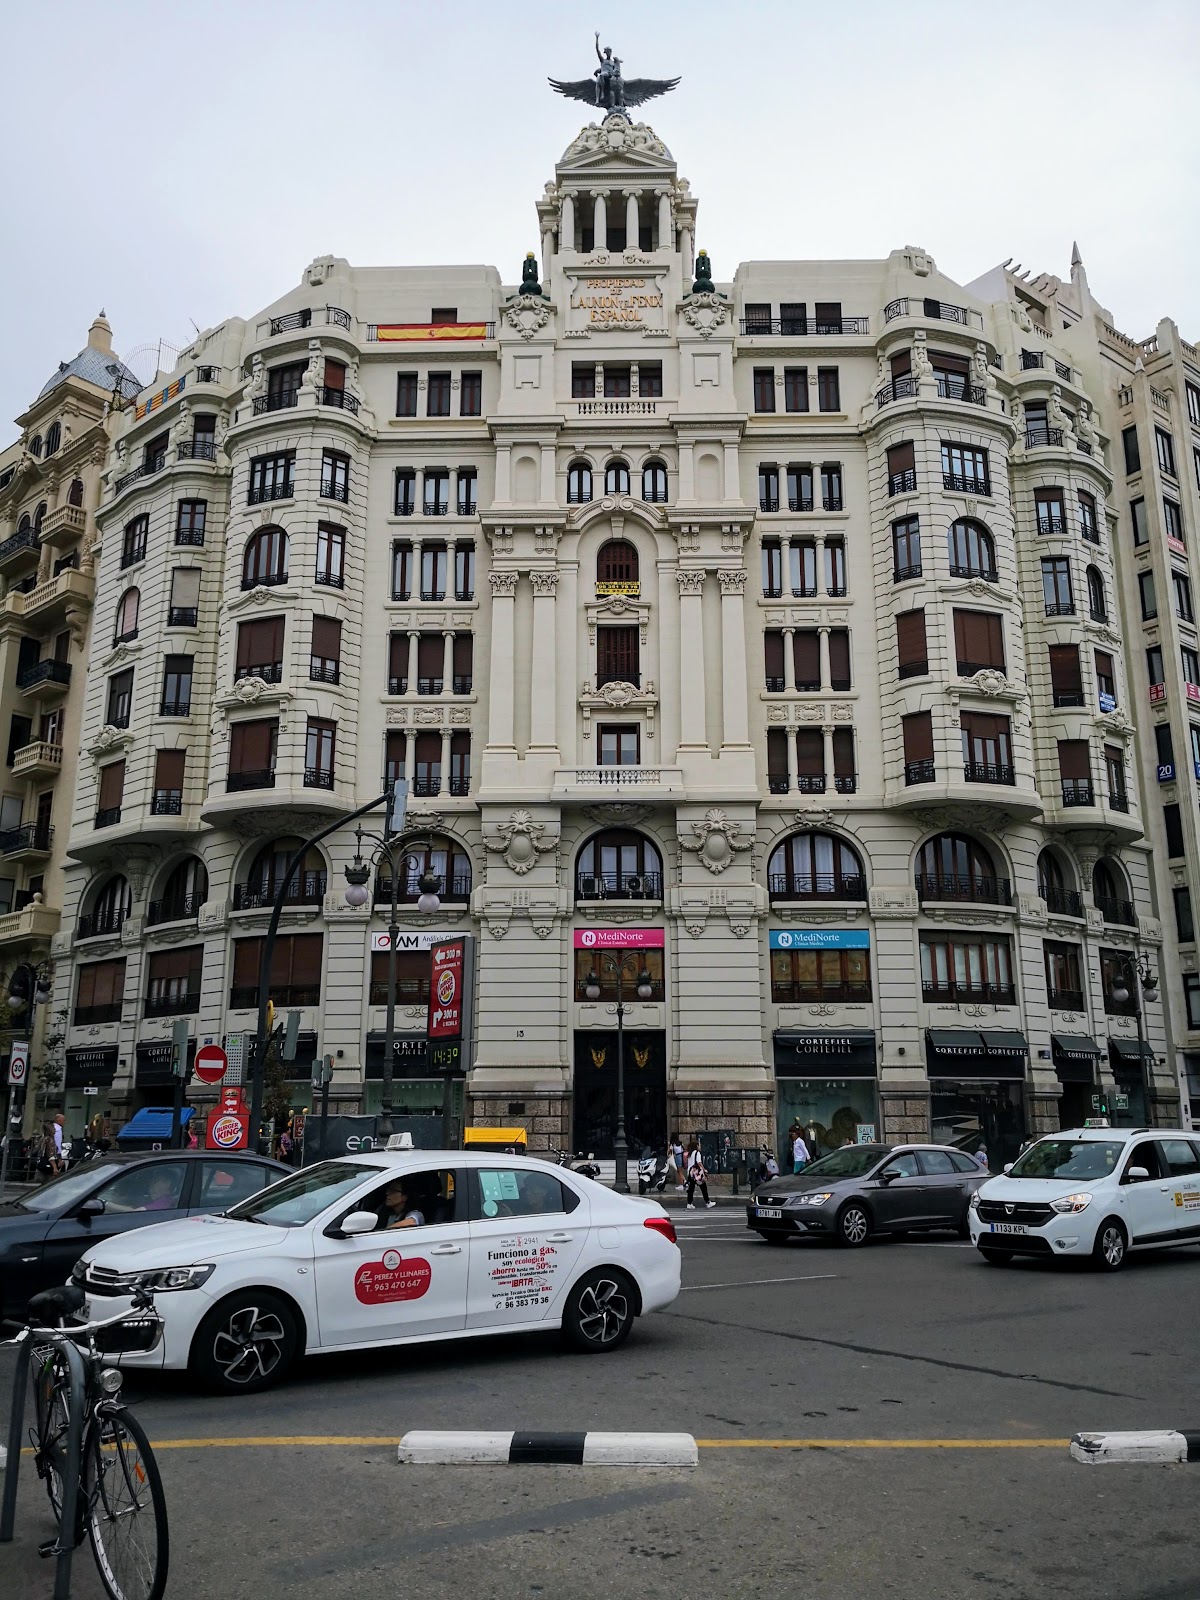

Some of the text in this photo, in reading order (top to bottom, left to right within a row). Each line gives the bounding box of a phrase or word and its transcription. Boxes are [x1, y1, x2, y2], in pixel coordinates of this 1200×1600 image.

[587, 279, 646, 288] PROPIEDAD
[571, 297, 586, 309] LA
[631, 296, 662, 308] FENIX
[591, 309, 642, 322] ESPAÑOL
[1159, 765, 1172, 776] 20
[598, 932, 643, 940] MediNorte
[795, 934, 839, 942] MediNorte
[440, 982, 454, 996] KING
[516, 1030, 525, 1038] 13
[935, 1047, 982, 1055] CORTEFIEL
[987, 1048, 1028, 1056] CORTEFIEL
[14, 1064, 22, 1072] 30
[217, 1122, 239, 1134] BURGER
[217, 1128, 240, 1140] KING
[995, 1225, 1028, 1234] 1133 KPL
[488, 1249, 529, 1260] Funciono
[492, 1267, 516, 1276] ahorro
[536, 1262, 552, 1270] 50%
[374, 1273, 394, 1281] PEREZ
[400, 1269, 430, 1278] LLINARES
[374, 1283, 389, 1291] 963
[391, 1281, 405, 1289] 470
[406, 1279, 421, 1287] 647
[505, 1301, 514, 1309] 96
[516, 1299, 528, 1307] 383
